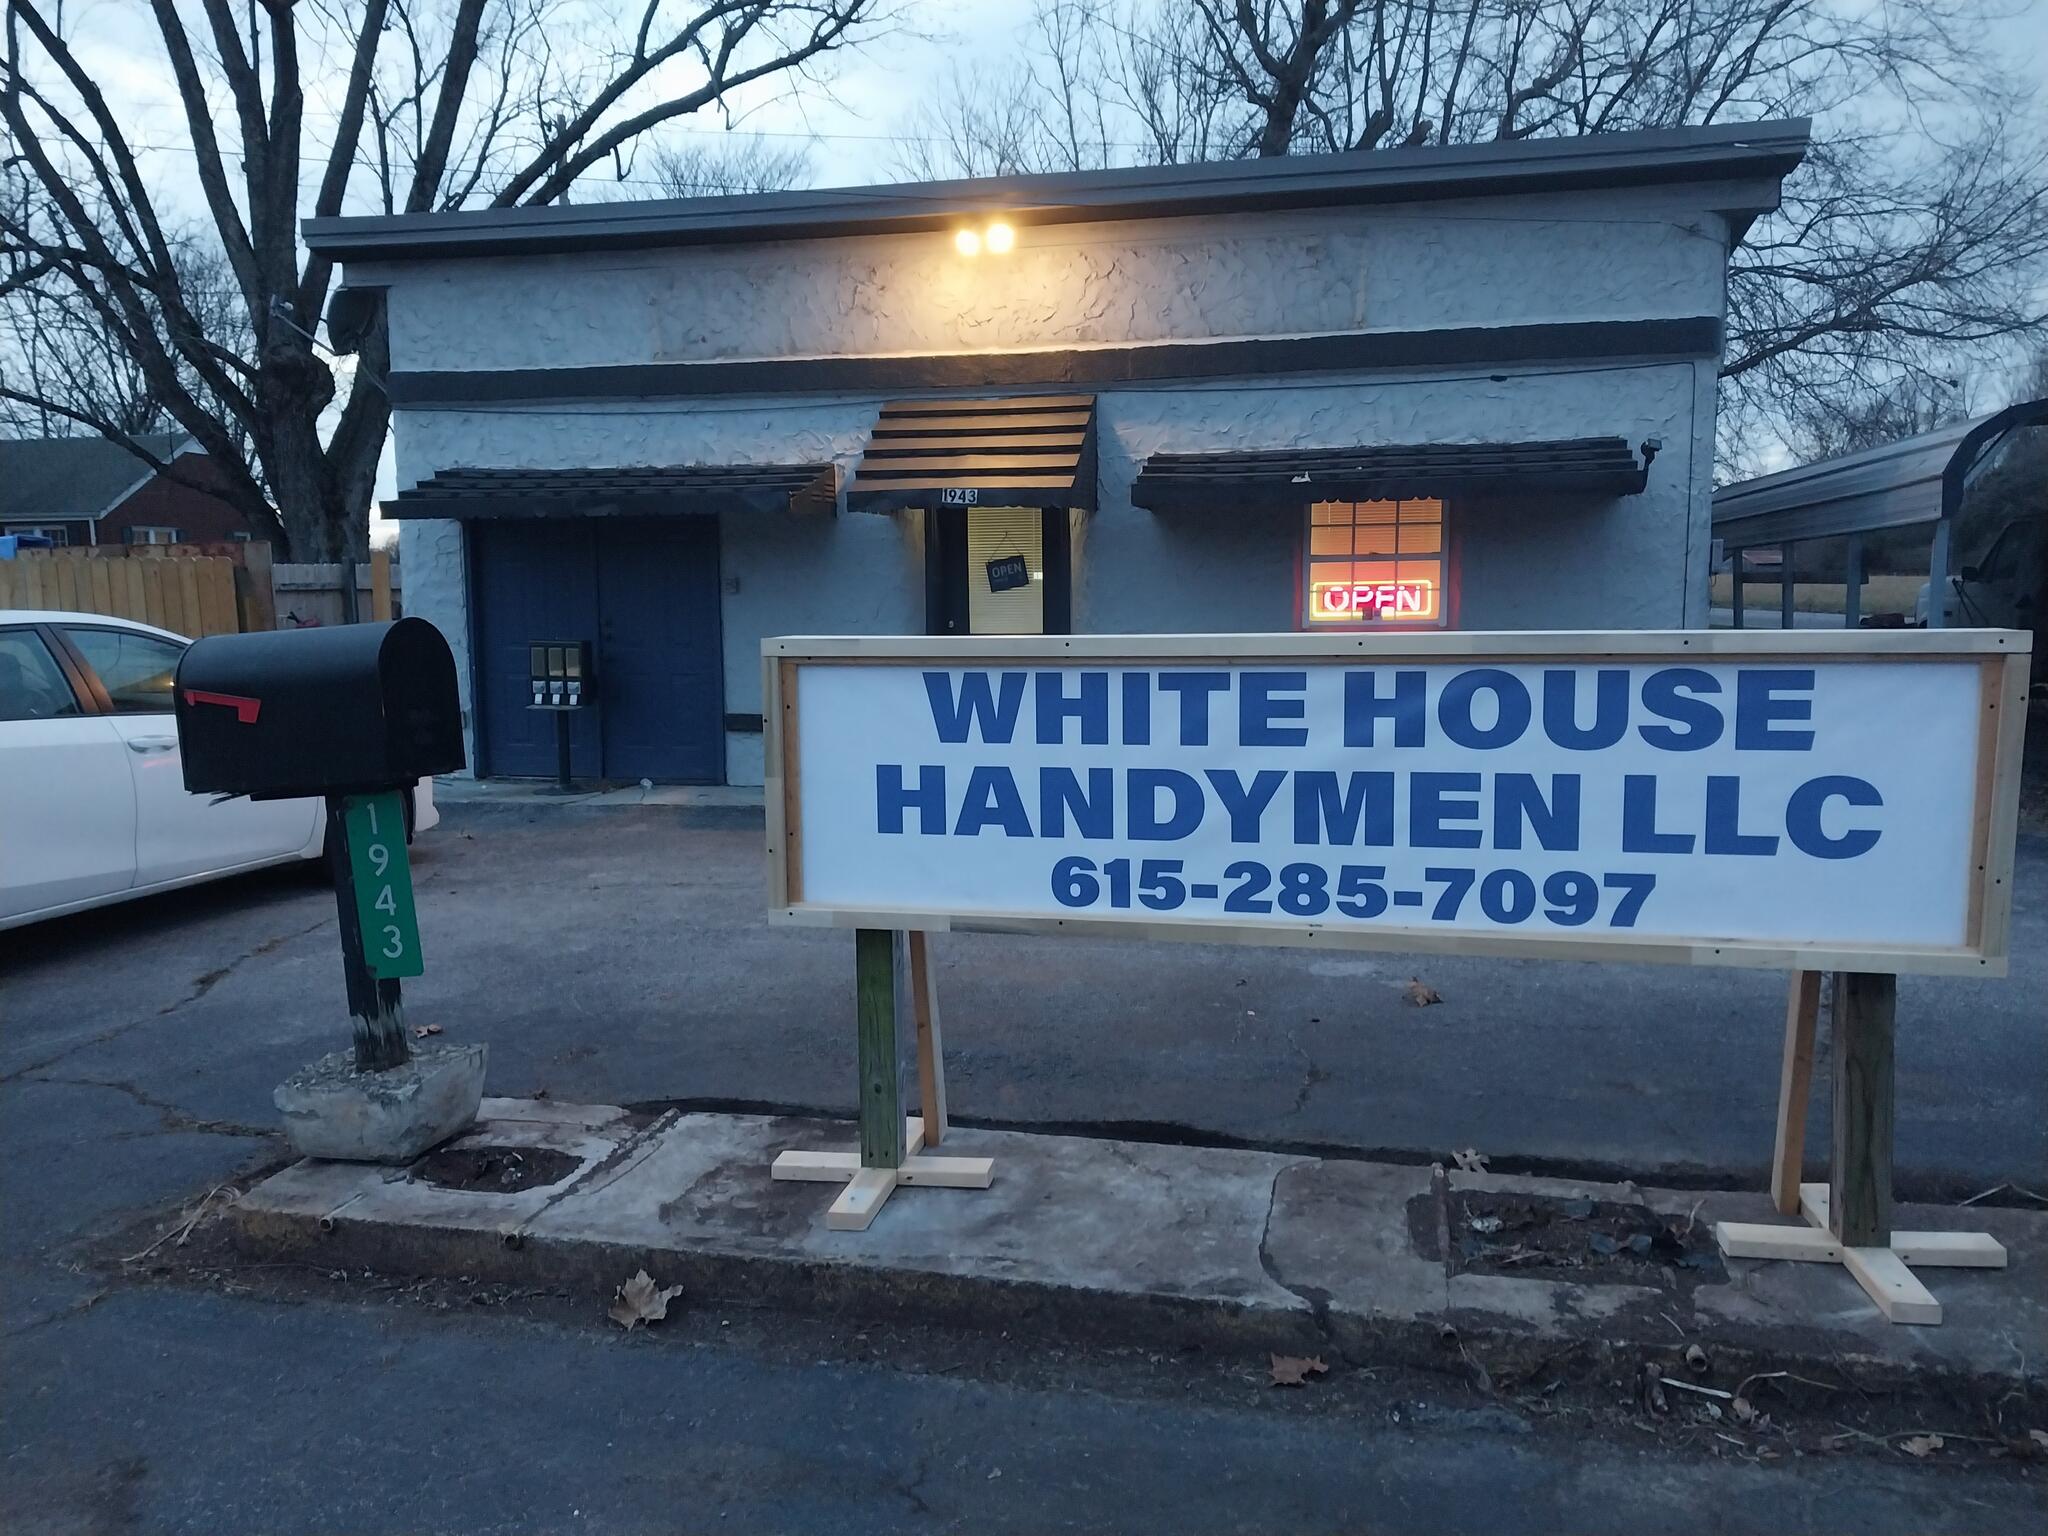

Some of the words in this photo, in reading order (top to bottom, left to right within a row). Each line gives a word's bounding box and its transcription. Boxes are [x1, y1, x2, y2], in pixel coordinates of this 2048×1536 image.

[943, 489, 978, 503] 1943
[992, 562, 1022, 578] OPEN
[1323, 585, 1422, 611] OPEN
[922, 671, 1309, 747] WHITE
[1343, 668, 1816, 751] HOUSE
[875, 764, 1582, 851] HANDYMEN
[1622, 774, 1885, 859] LLC
[366, 802, 404, 959] 1943
[1050, 856, 1657, 928] 615-285-7097
